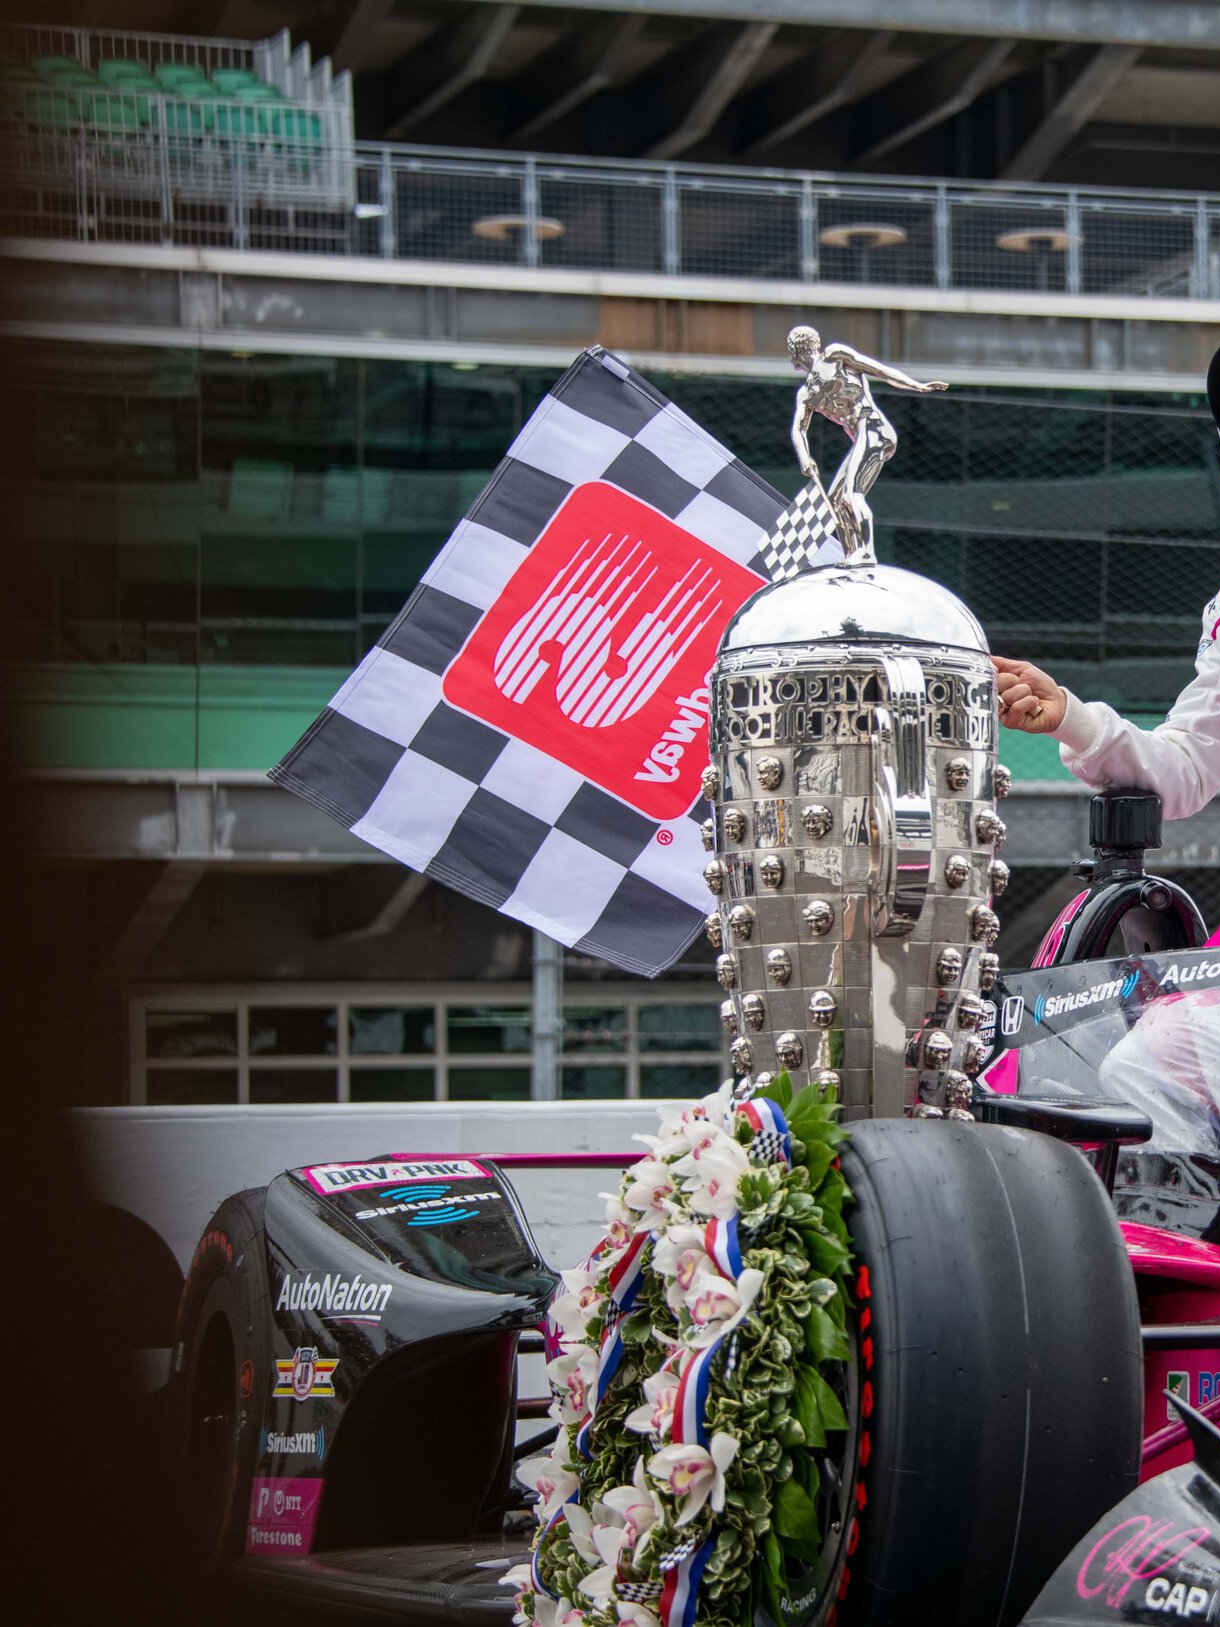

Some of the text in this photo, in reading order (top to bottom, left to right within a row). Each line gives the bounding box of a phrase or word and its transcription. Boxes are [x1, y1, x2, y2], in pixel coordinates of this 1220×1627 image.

[324, 1166, 388, 1186] DRV
[402, 1162, 469, 1177] PNK
[275, 1272, 393, 1312] AutoNation
[285, 1496, 301, 1510] NTT
[251, 1527, 302, 1546] Firestone
[1145, 1577, 1208, 1617] CAP
